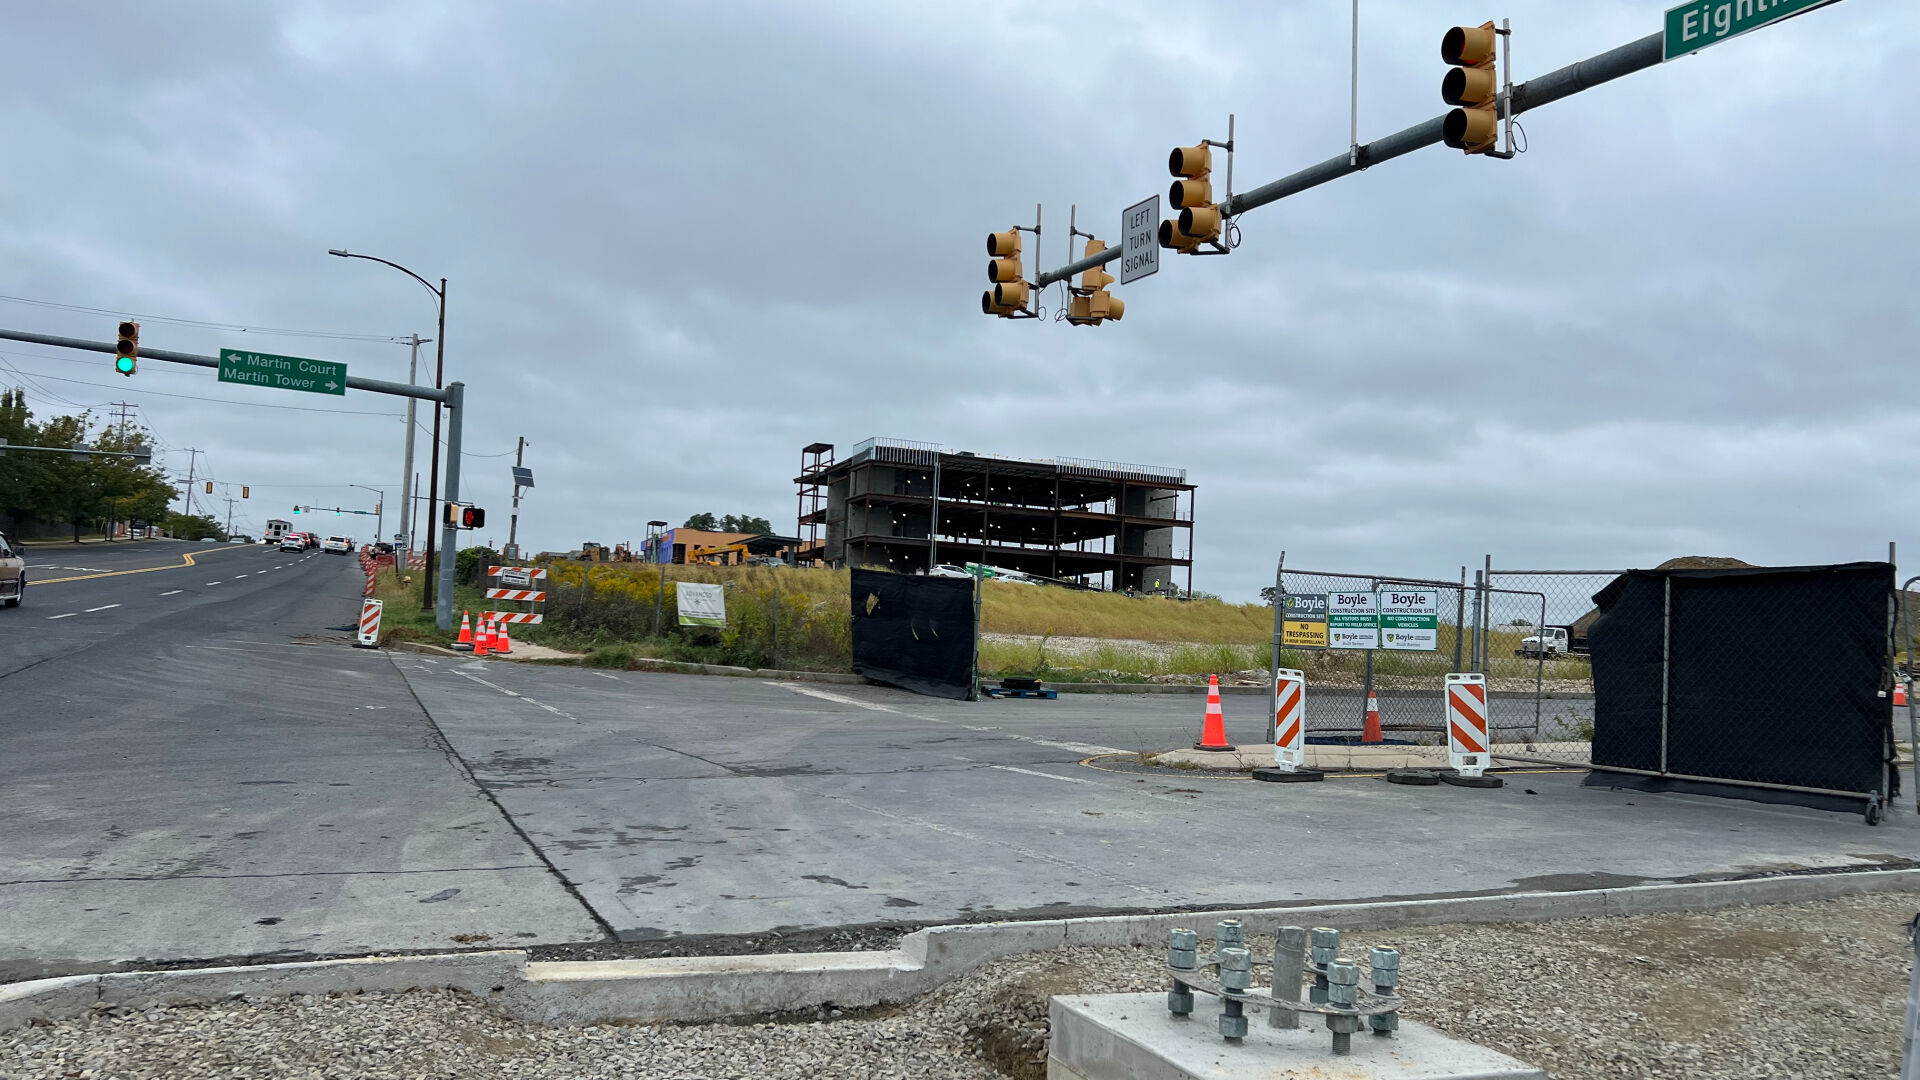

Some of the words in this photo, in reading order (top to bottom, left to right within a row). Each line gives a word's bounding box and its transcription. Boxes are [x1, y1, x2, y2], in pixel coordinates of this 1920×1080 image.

[1682, 0, 1787, 42] Eight
[1130, 208, 1150, 229] LEFT
[1129, 229, 1152, 251] TURN
[1125, 250, 1155, 273] SIGNAL
[247, 354, 291, 370] Martin
[298, 360, 337, 376] Court
[224, 367, 269, 383] Martin
[274, 373, 315, 389] Tower
[1294, 596, 1325, 612] Boyle
[1337, 593, 1367, 607] Boyle
[1391, 593, 1426, 607] Boyle
[1285, 630, 1324, 639] TRESPASSING
[1341, 633, 1358, 641] Boyle
[1395, 633, 1414, 642] Boyle
